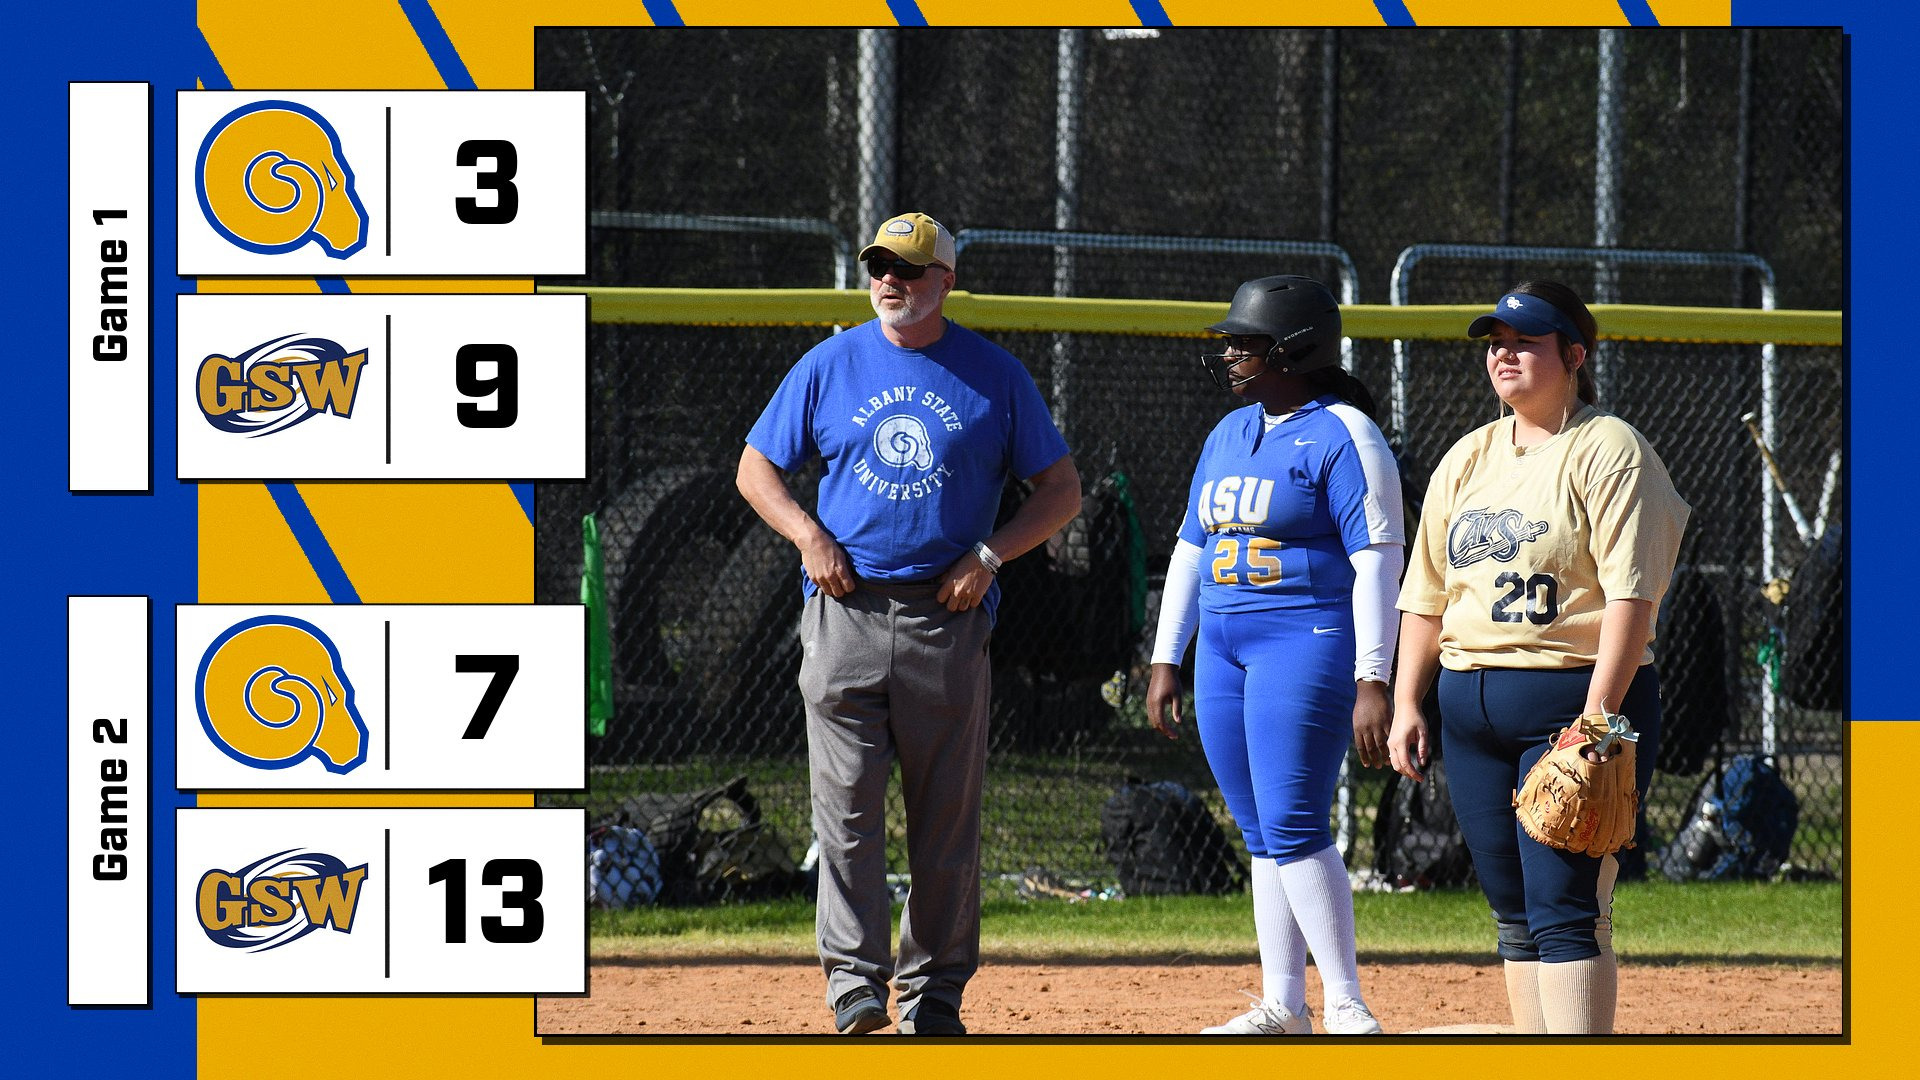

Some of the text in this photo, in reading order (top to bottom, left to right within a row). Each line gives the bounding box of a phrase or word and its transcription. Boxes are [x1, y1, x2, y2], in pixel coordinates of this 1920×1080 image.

[852, 386, 963, 432] ALBANY STATE
[853, 458, 954, 501] UNIVERSITY
[1198, 476, 1275, 527] ASU
[1212, 538, 1282, 586] 25
[1492, 572, 1559, 625] 20
